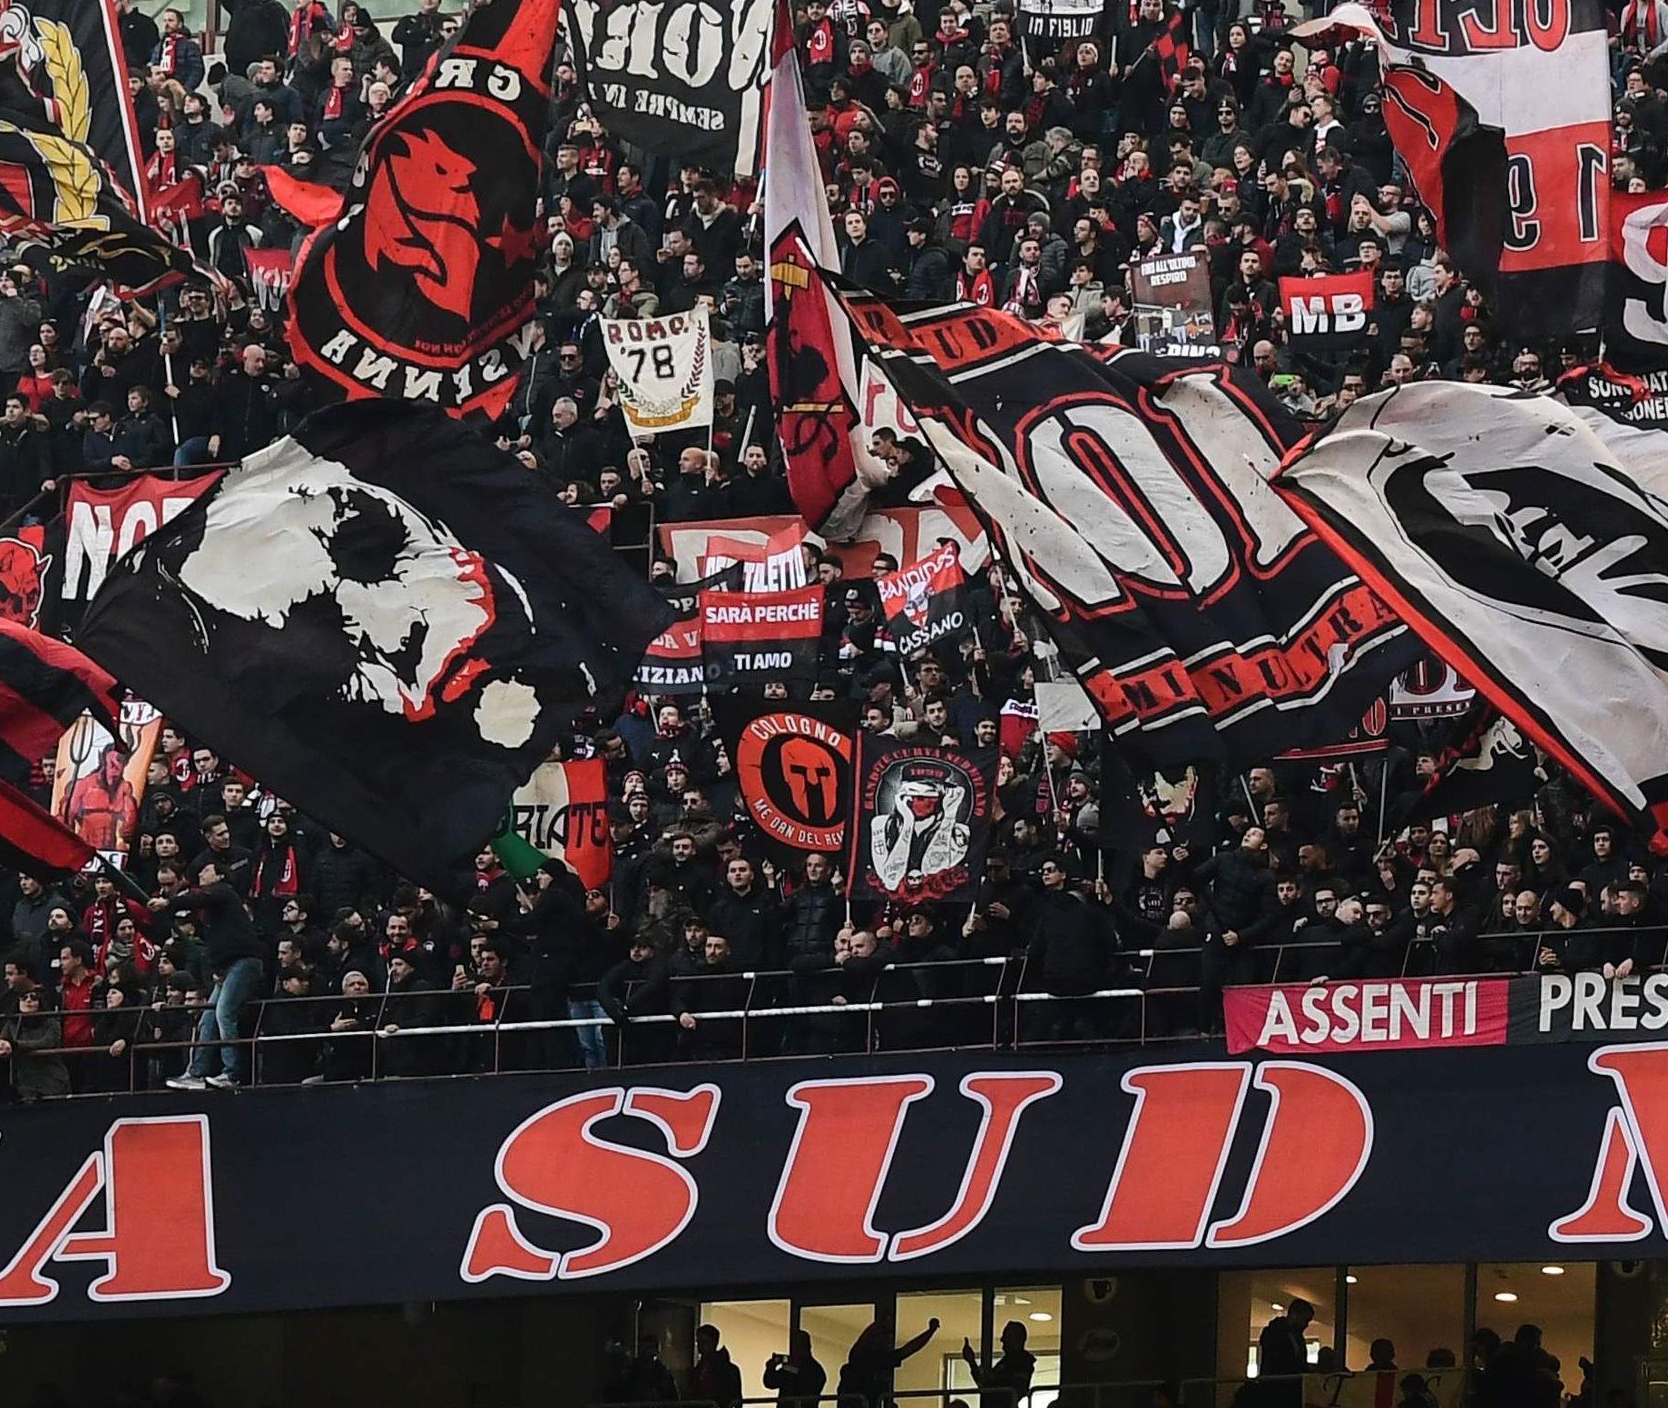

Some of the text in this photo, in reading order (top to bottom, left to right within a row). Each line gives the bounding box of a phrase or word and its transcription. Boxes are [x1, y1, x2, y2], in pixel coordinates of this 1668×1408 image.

[1291, 294, 1367, 334] MB
[706, 603, 753, 624] SARÀ
[898, 612, 963, 655] CASSANO
[734, 652, 792, 670] TI AMO
[750, 714, 842, 748] COLOGNO
[1259, 980, 1479, 1047] ASSENTI
[461, 1060, 1375, 1284] SUD
